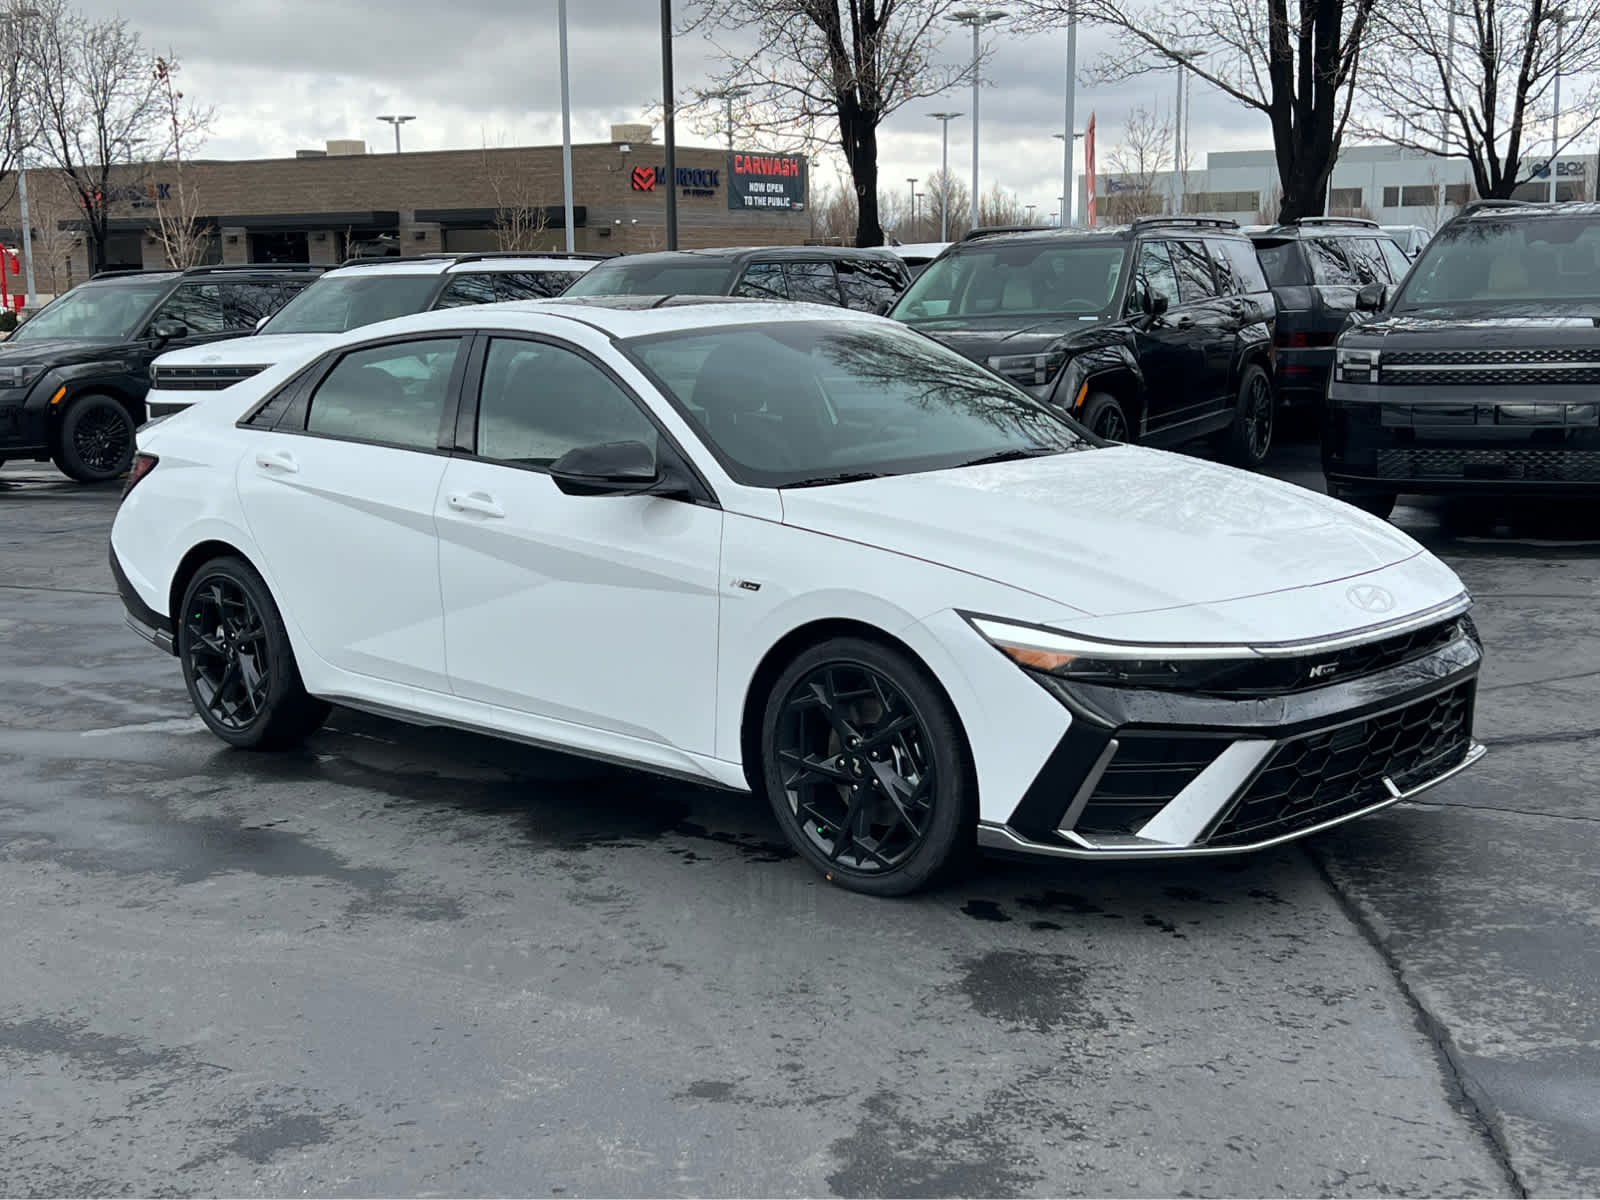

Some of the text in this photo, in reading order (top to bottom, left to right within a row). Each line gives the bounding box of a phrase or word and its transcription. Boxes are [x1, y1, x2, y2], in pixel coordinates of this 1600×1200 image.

[735, 155, 799, 177] CARWASH
[749, 182, 784, 193] NOW OPEN
[744, 196, 753, 206] TO
[754, 196, 767, 206] THE
[768, 197, 790, 207] PUBLIC
